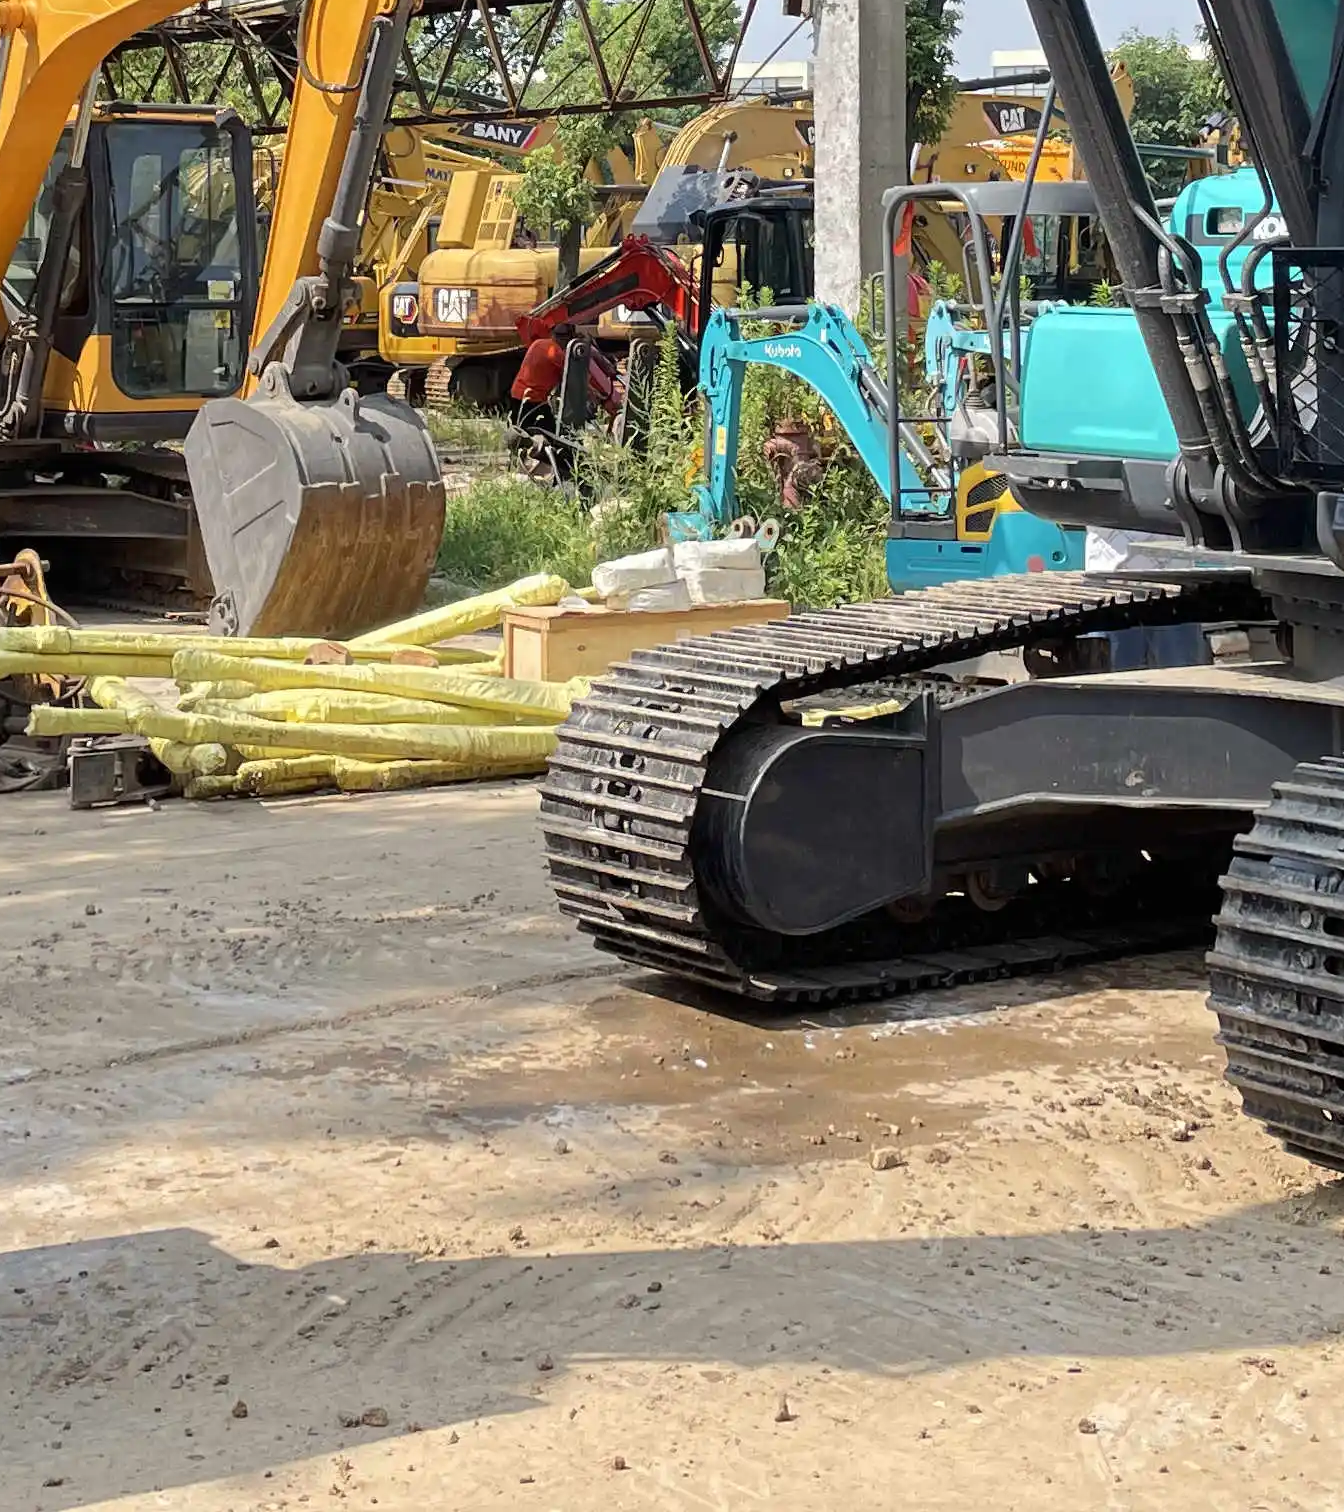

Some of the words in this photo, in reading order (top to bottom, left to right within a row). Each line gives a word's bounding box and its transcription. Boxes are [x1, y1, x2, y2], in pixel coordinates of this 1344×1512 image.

[999, 106, 1026, 133] CAT
[473, 122, 522, 144] SANY
[393, 295, 412, 318] CAT
[438, 288, 471, 323] CAT
[764, 343, 802, 358] Kubota
